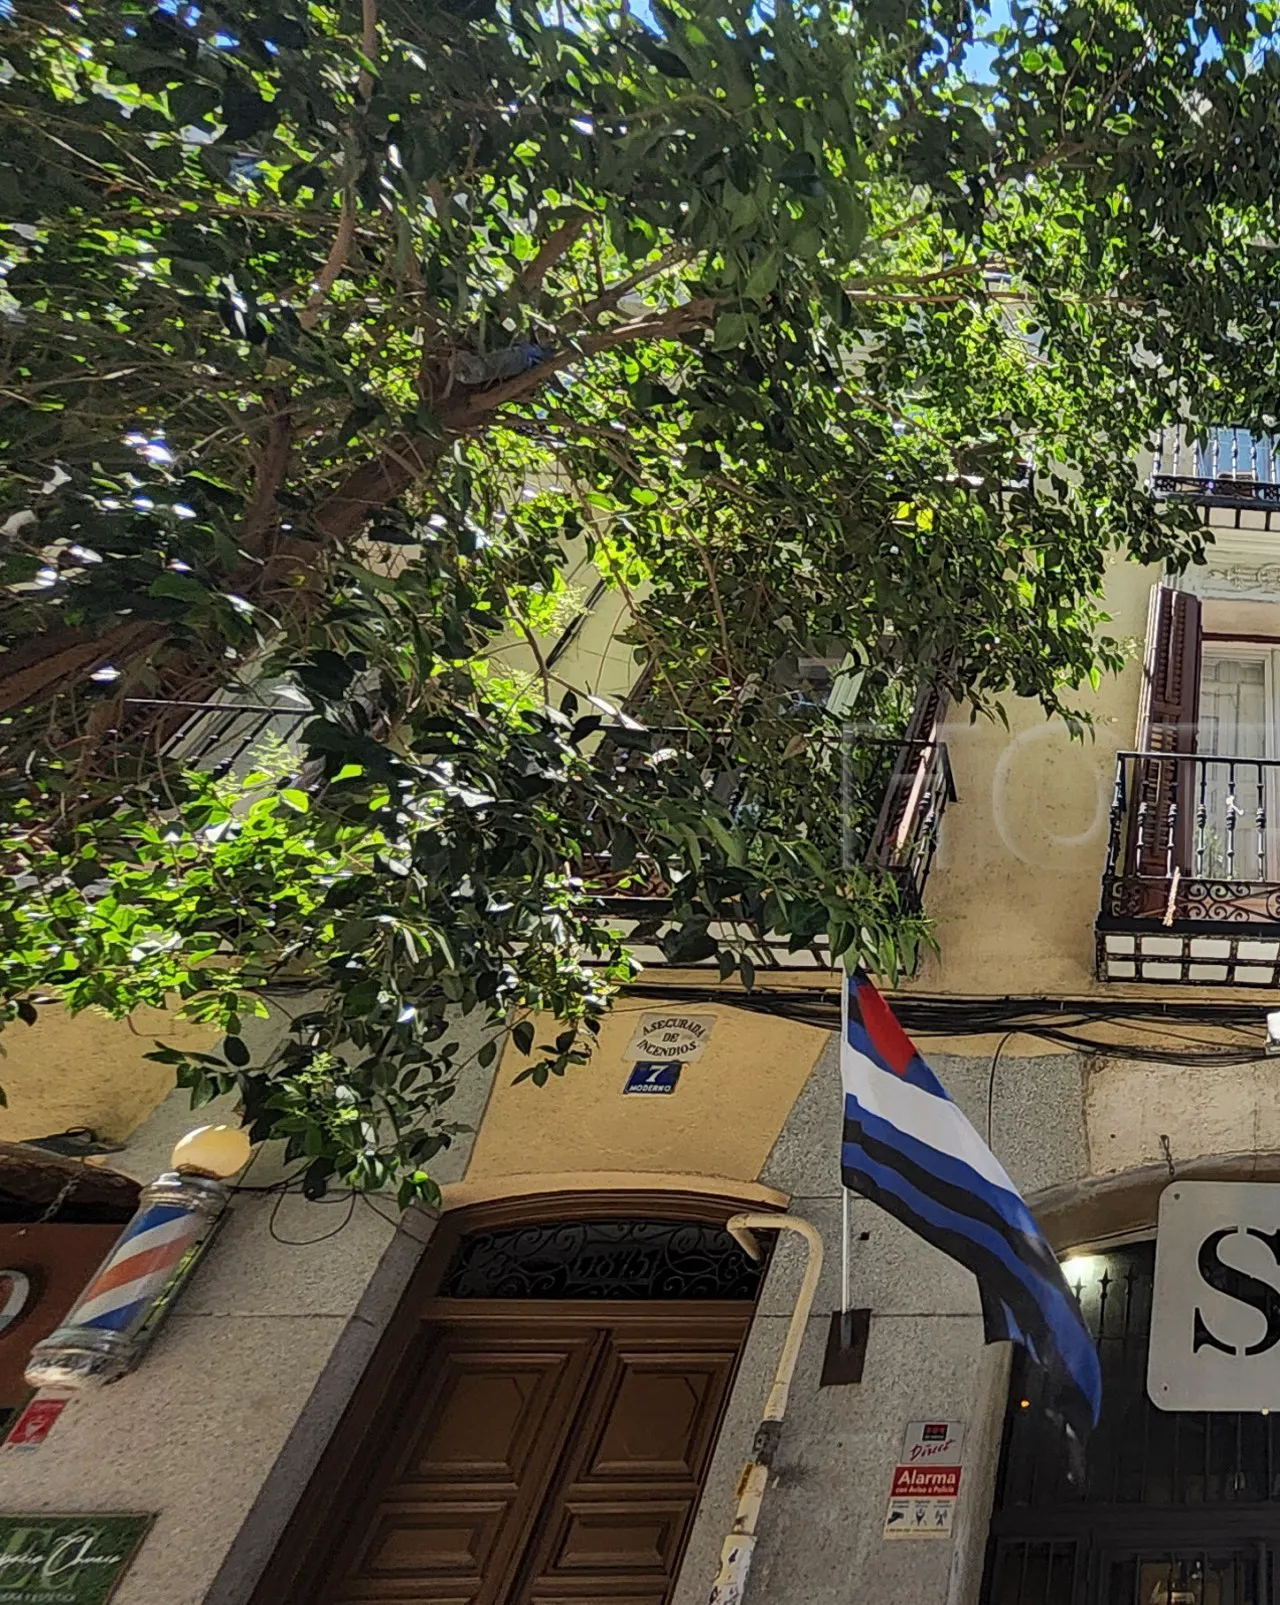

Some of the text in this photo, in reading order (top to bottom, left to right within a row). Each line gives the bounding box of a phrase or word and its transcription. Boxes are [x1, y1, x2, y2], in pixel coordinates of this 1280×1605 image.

[642, 1018, 707, 1038] ASEGURADA
[662, 1033, 680, 1043] DE
[636, 1039, 698, 1057] INCENDIOS
[645, 1065, 669, 1083] 7
[629, 1084, 671, 1093] MODERNO
[897, 1469, 956, 1485] Alarma
